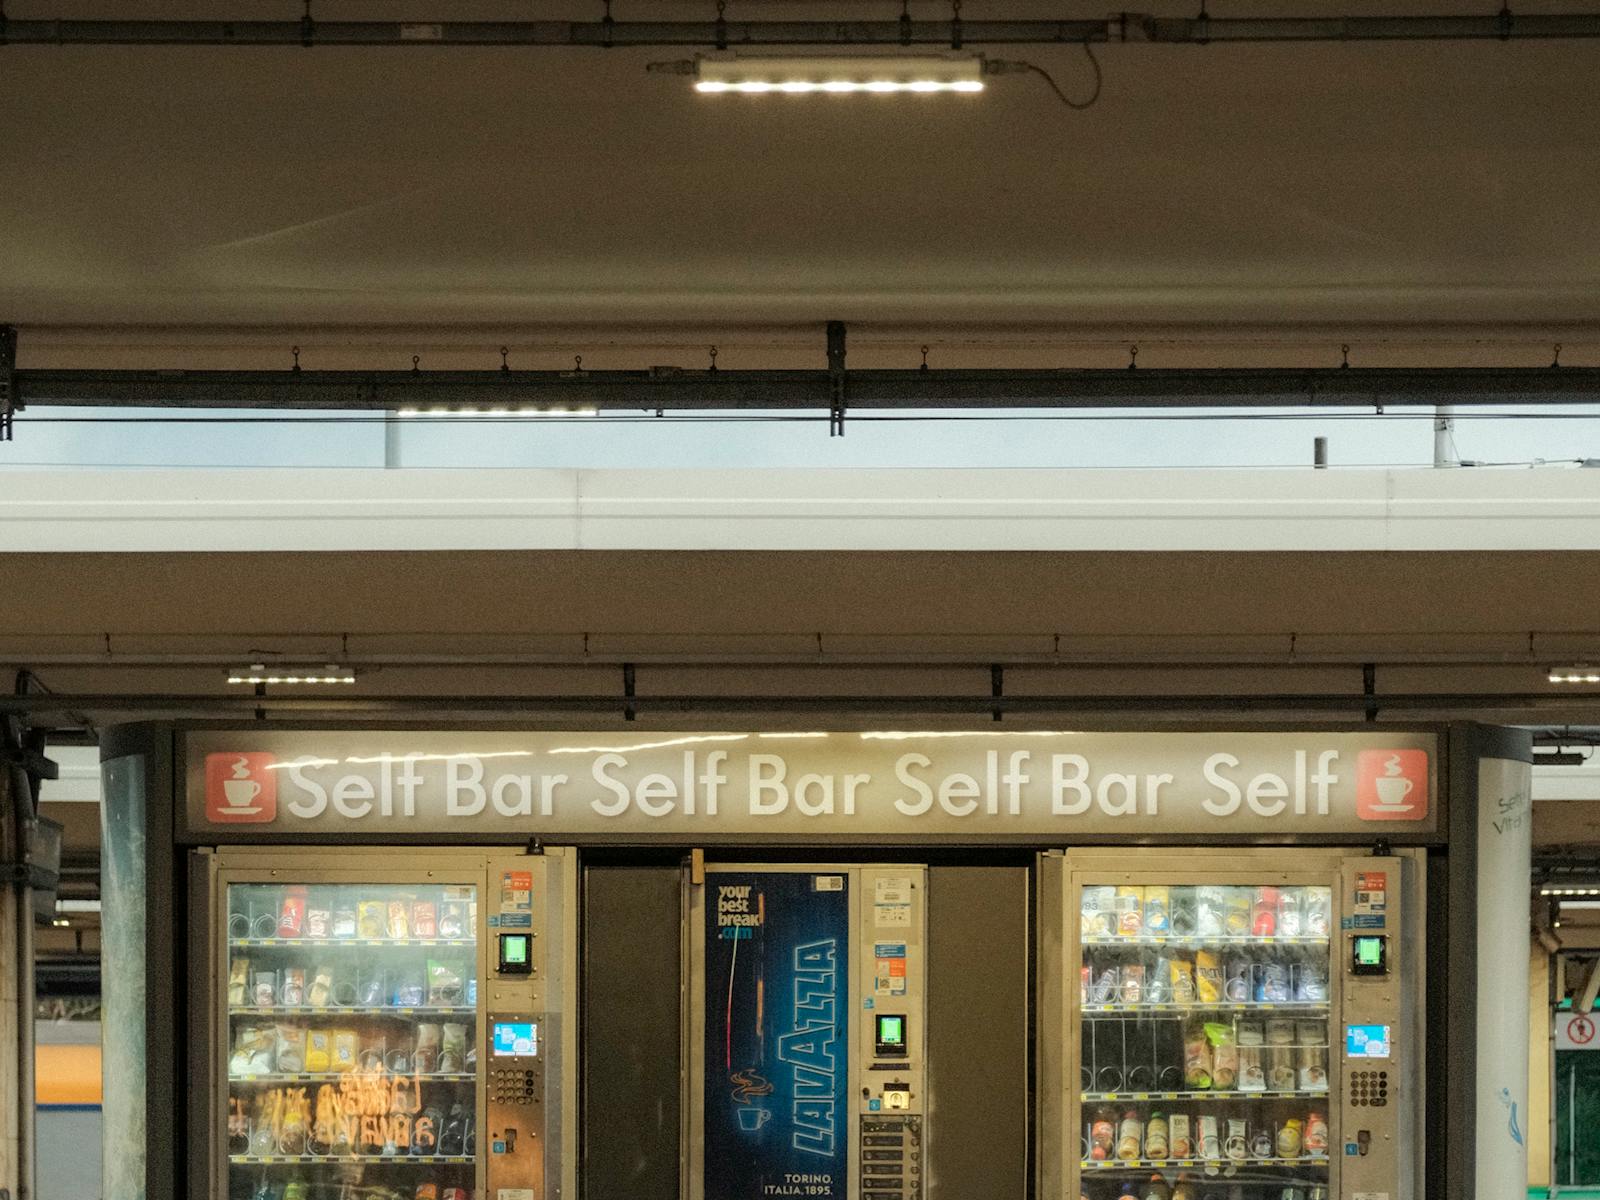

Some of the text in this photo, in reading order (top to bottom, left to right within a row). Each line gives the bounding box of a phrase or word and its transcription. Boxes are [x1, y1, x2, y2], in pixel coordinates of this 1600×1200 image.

[287, 749, 1340, 819] Self Bar Self Bar Self Bar Self
[718, 885, 752, 899] your
[718, 897, 749, 912] best
[718, 912, 760, 927] break
[778, 938, 836, 1157] LAVAZZA
[784, 1173, 834, 1184] TORINO.
[804, 1185, 834, 1196] 1895.
